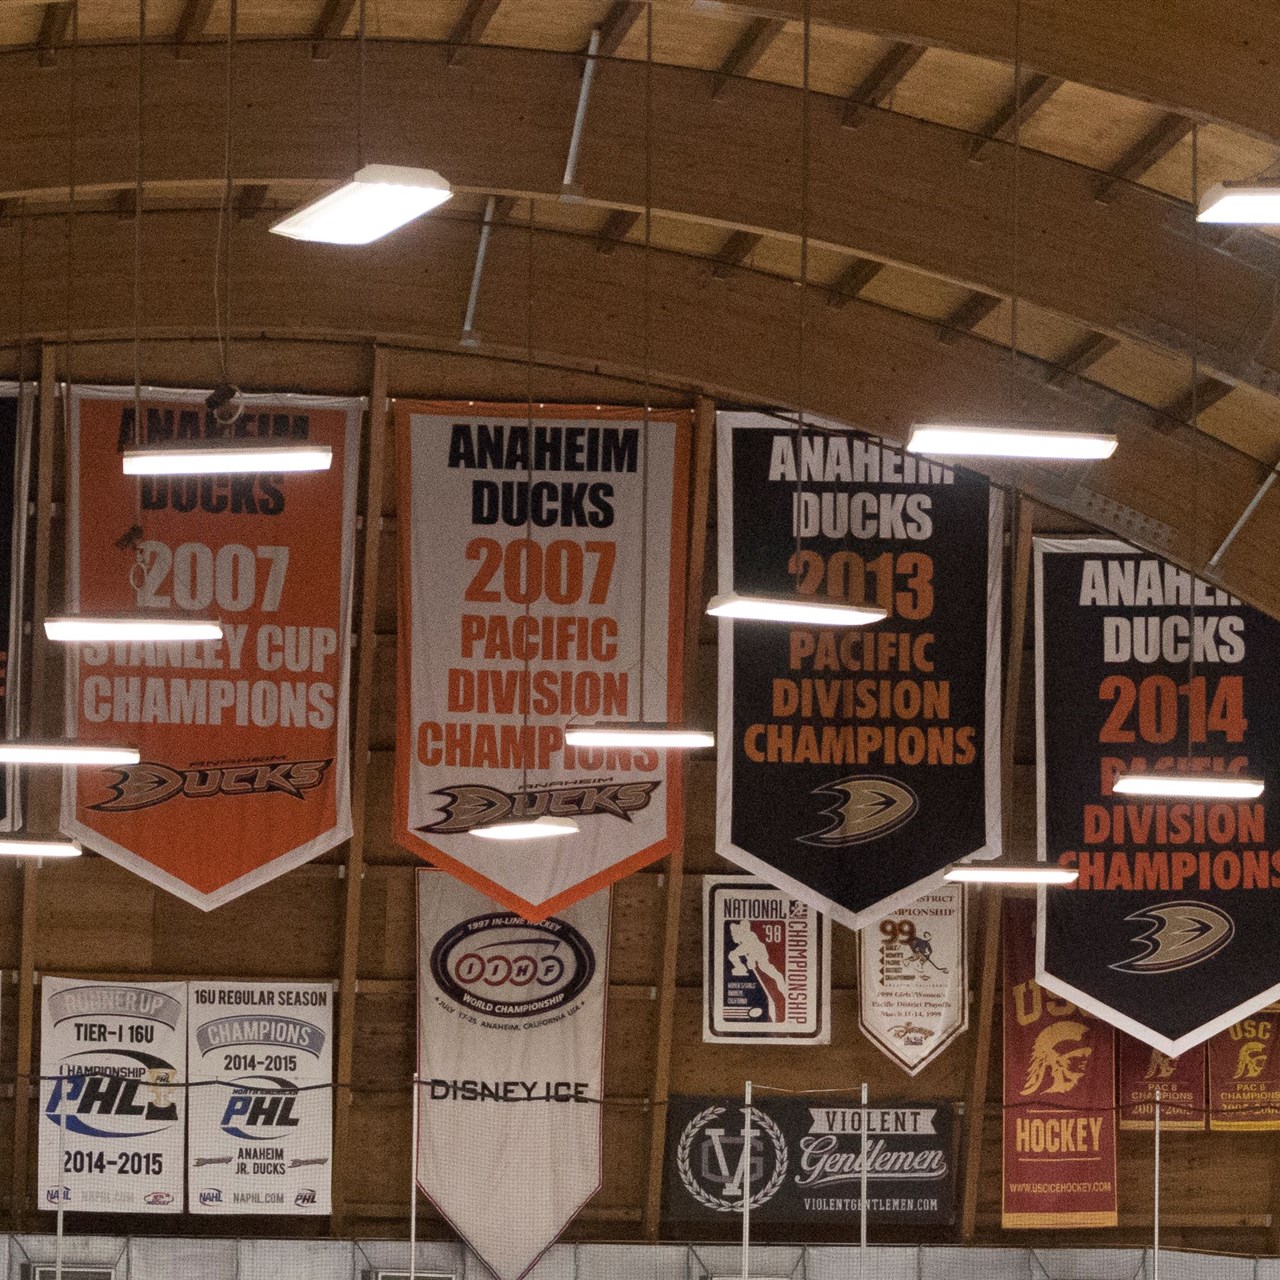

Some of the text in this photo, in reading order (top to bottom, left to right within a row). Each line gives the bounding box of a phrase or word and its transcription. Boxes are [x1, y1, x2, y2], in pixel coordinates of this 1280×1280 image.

[448, 423, 639, 473] ANAHEIM
[141, 474, 285, 516] DUCKS
[471, 479, 615, 528] DUCKS
[792, 492, 933, 540] DUCKS
[135, 540, 290, 613] 2007
[464, 537, 617, 605] 2007
[787, 550, 934, 620] 2013
[1079, 560, 1242, 606] ANAHE
[256, 625, 337, 673] CUP
[460, 614, 618, 663] PACIFIC
[789, 627, 935, 673] PACIFIC
[1104, 615, 1245, 663] DUCKS
[83, 675, 335, 729] CHAMPIONS
[447, 668, 628, 718] DIVISION
[772, 679, 950, 720] DIVISION
[1098, 675, 1248, 744] 2014
[743, 725, 977, 766] CHAMPIONS
[85, 757, 334, 812] DUCKS
[518, 777, 614, 790] ANAHEIM
[414, 781, 663, 834] DUCKS
[1084, 804, 1265, 844] DIVISION
[467, 918, 489, 931] 1997
[723, 898, 787, 919] NATIONAL
[762, 924, 781, 943] '98
[879, 919, 918, 944] 99
[787, 920, 808, 1025] CHAMPIONSHIP
[194, 990, 327, 1006] 16U REGULAR SEASON
[438, 1000, 455, 1014] JULY
[462, 993, 565, 1014] WORLD CHAMPIONSHIP
[128, 1024, 154, 1043] 16U
[208, 1019, 311, 1046] CHAMPIONS
[1228, 1020, 1272, 1041] USC
[224, 1055, 297, 1071] 2014-2015
[46, 1074, 146, 1115] PHL
[430, 1079, 589, 1104] DISNEY ICE
[1149, 1083, 1169, 1091] PAC
[1220, 1091, 1280, 1100] CHAMPIONS
[1236, 1083, 1257, 1091] PAC
[220, 1096, 300, 1126] PHL
[825, 1110, 921, 1132] VIOLENT
[1016, 1117, 1102, 1153] HOCKEY
[64, 1150, 163, 1175] 2014-2015
[235, 1163, 286, 1175] JR. DUCKS
[237, 1148, 284, 1161] ANAHEIM
[199, 1191, 222, 1203] NAHL
[233, 1193, 284, 1204] NAPHL.COM
